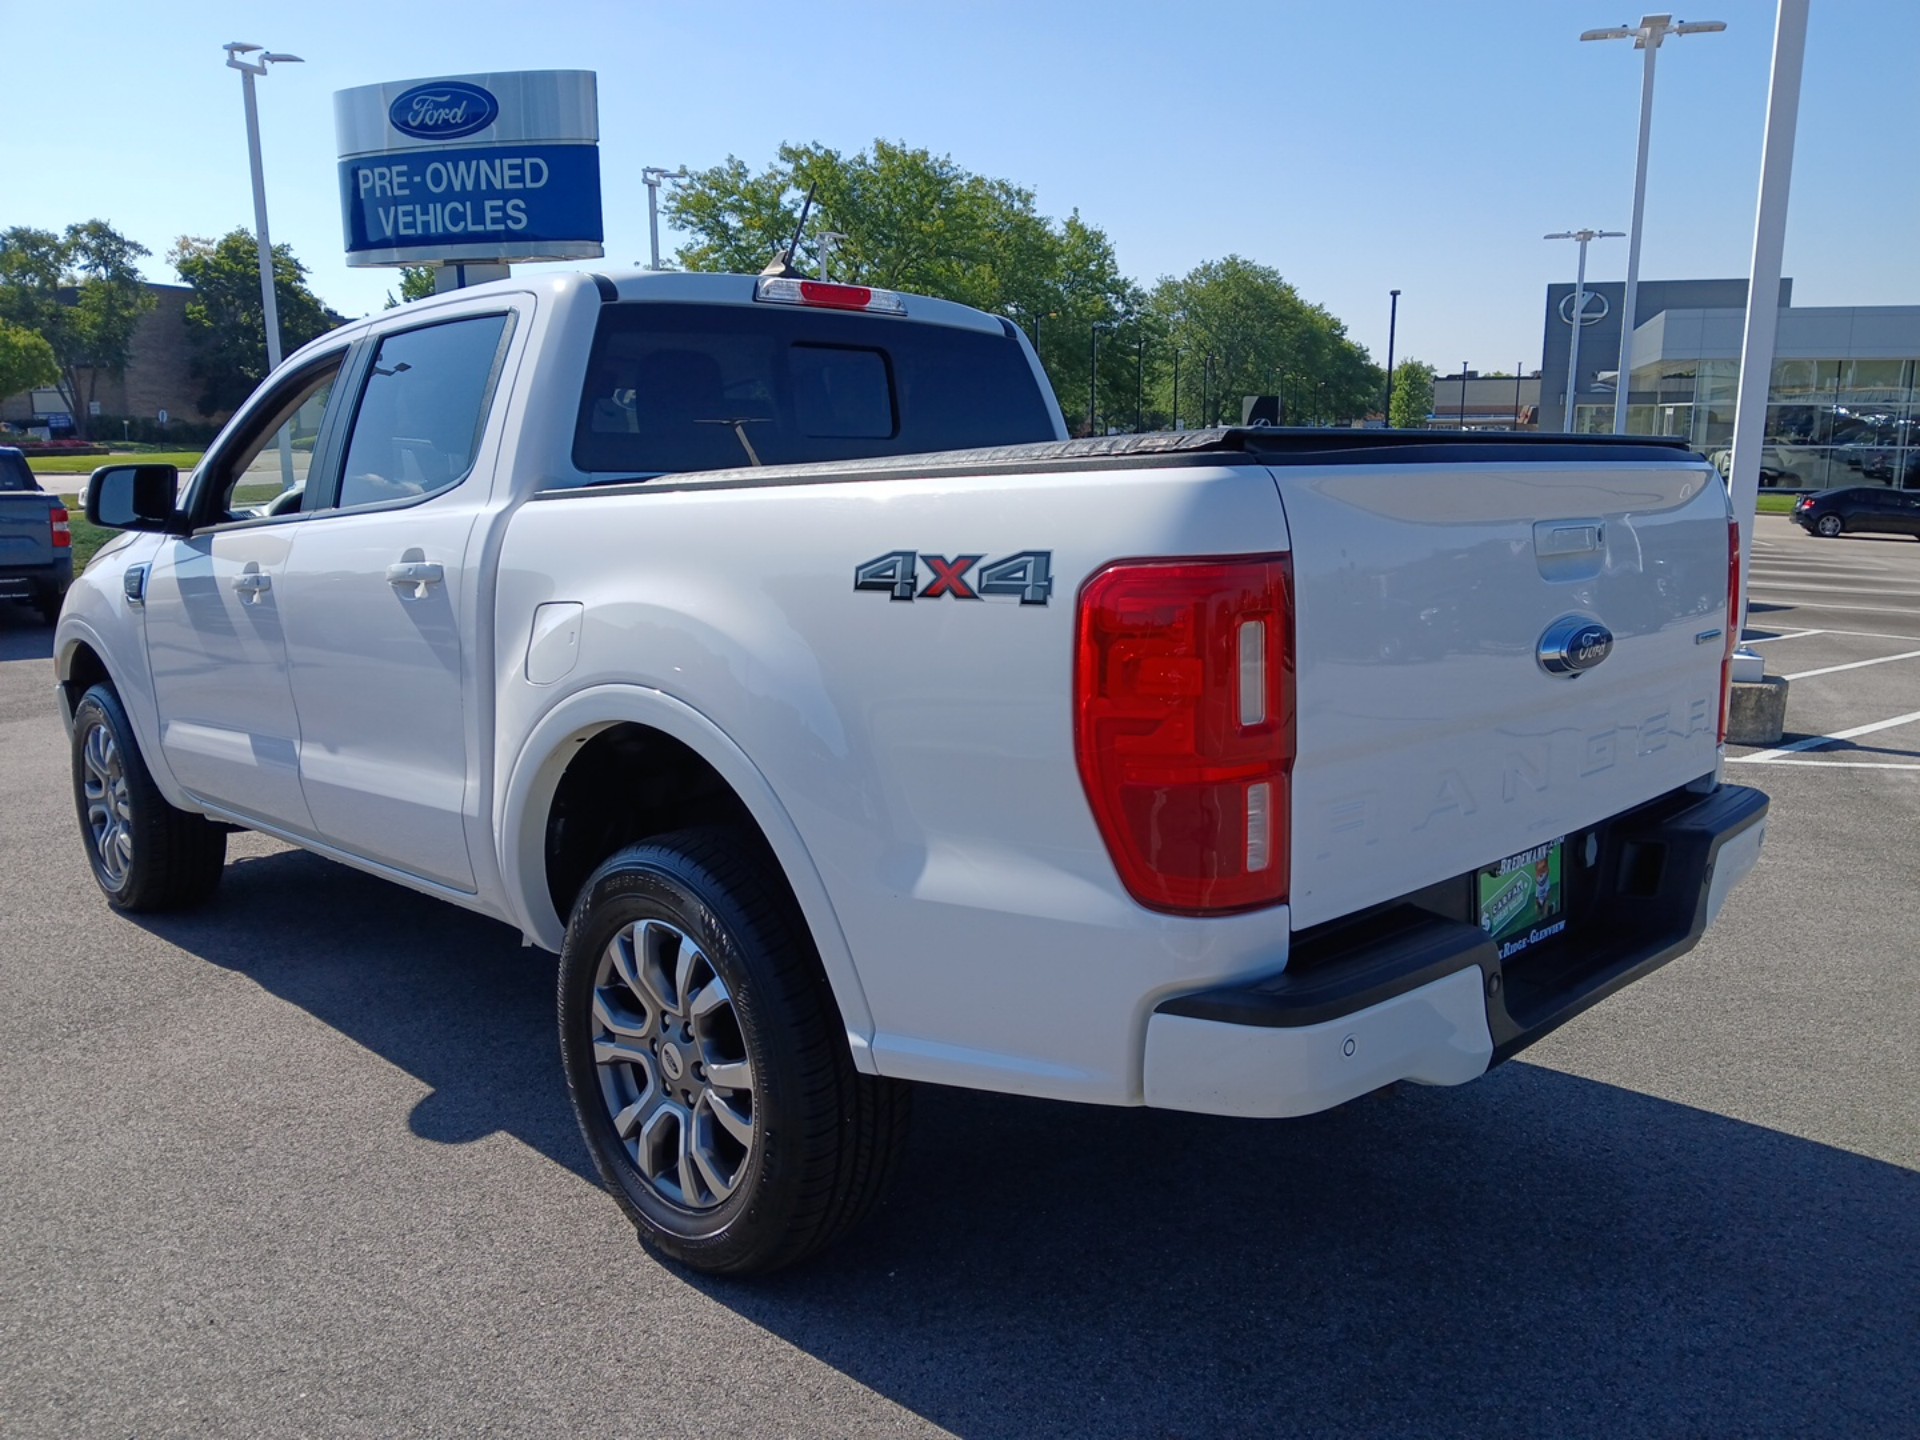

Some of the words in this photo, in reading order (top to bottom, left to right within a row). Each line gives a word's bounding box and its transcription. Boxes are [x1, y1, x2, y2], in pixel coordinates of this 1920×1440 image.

[407, 94, 468, 127] Ford
[377, 198, 529, 237] VEHICLES
[1578, 631, 1607, 661] Ford
[1316, 692, 1712, 861] RANGER
